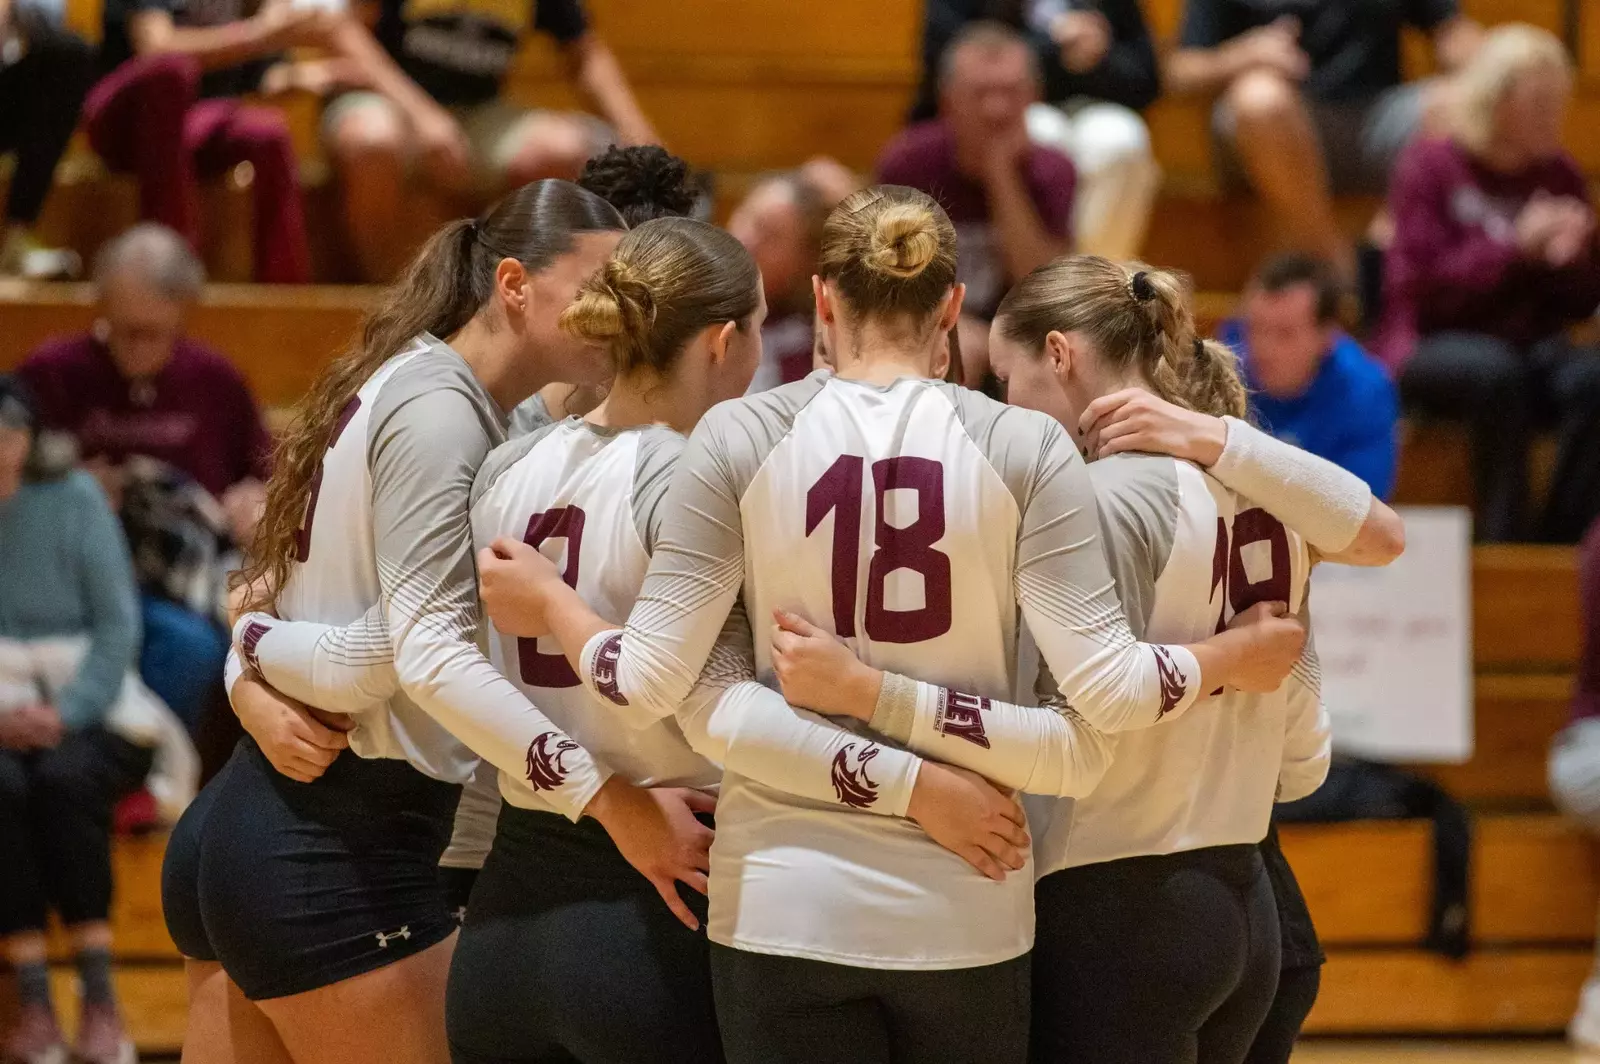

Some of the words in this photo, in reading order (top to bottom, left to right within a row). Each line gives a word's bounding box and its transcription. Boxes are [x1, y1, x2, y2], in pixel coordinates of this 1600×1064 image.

[806, 454, 952, 643] 18
[595, 634, 629, 706] LEY
[942, 688, 991, 750] LEY
